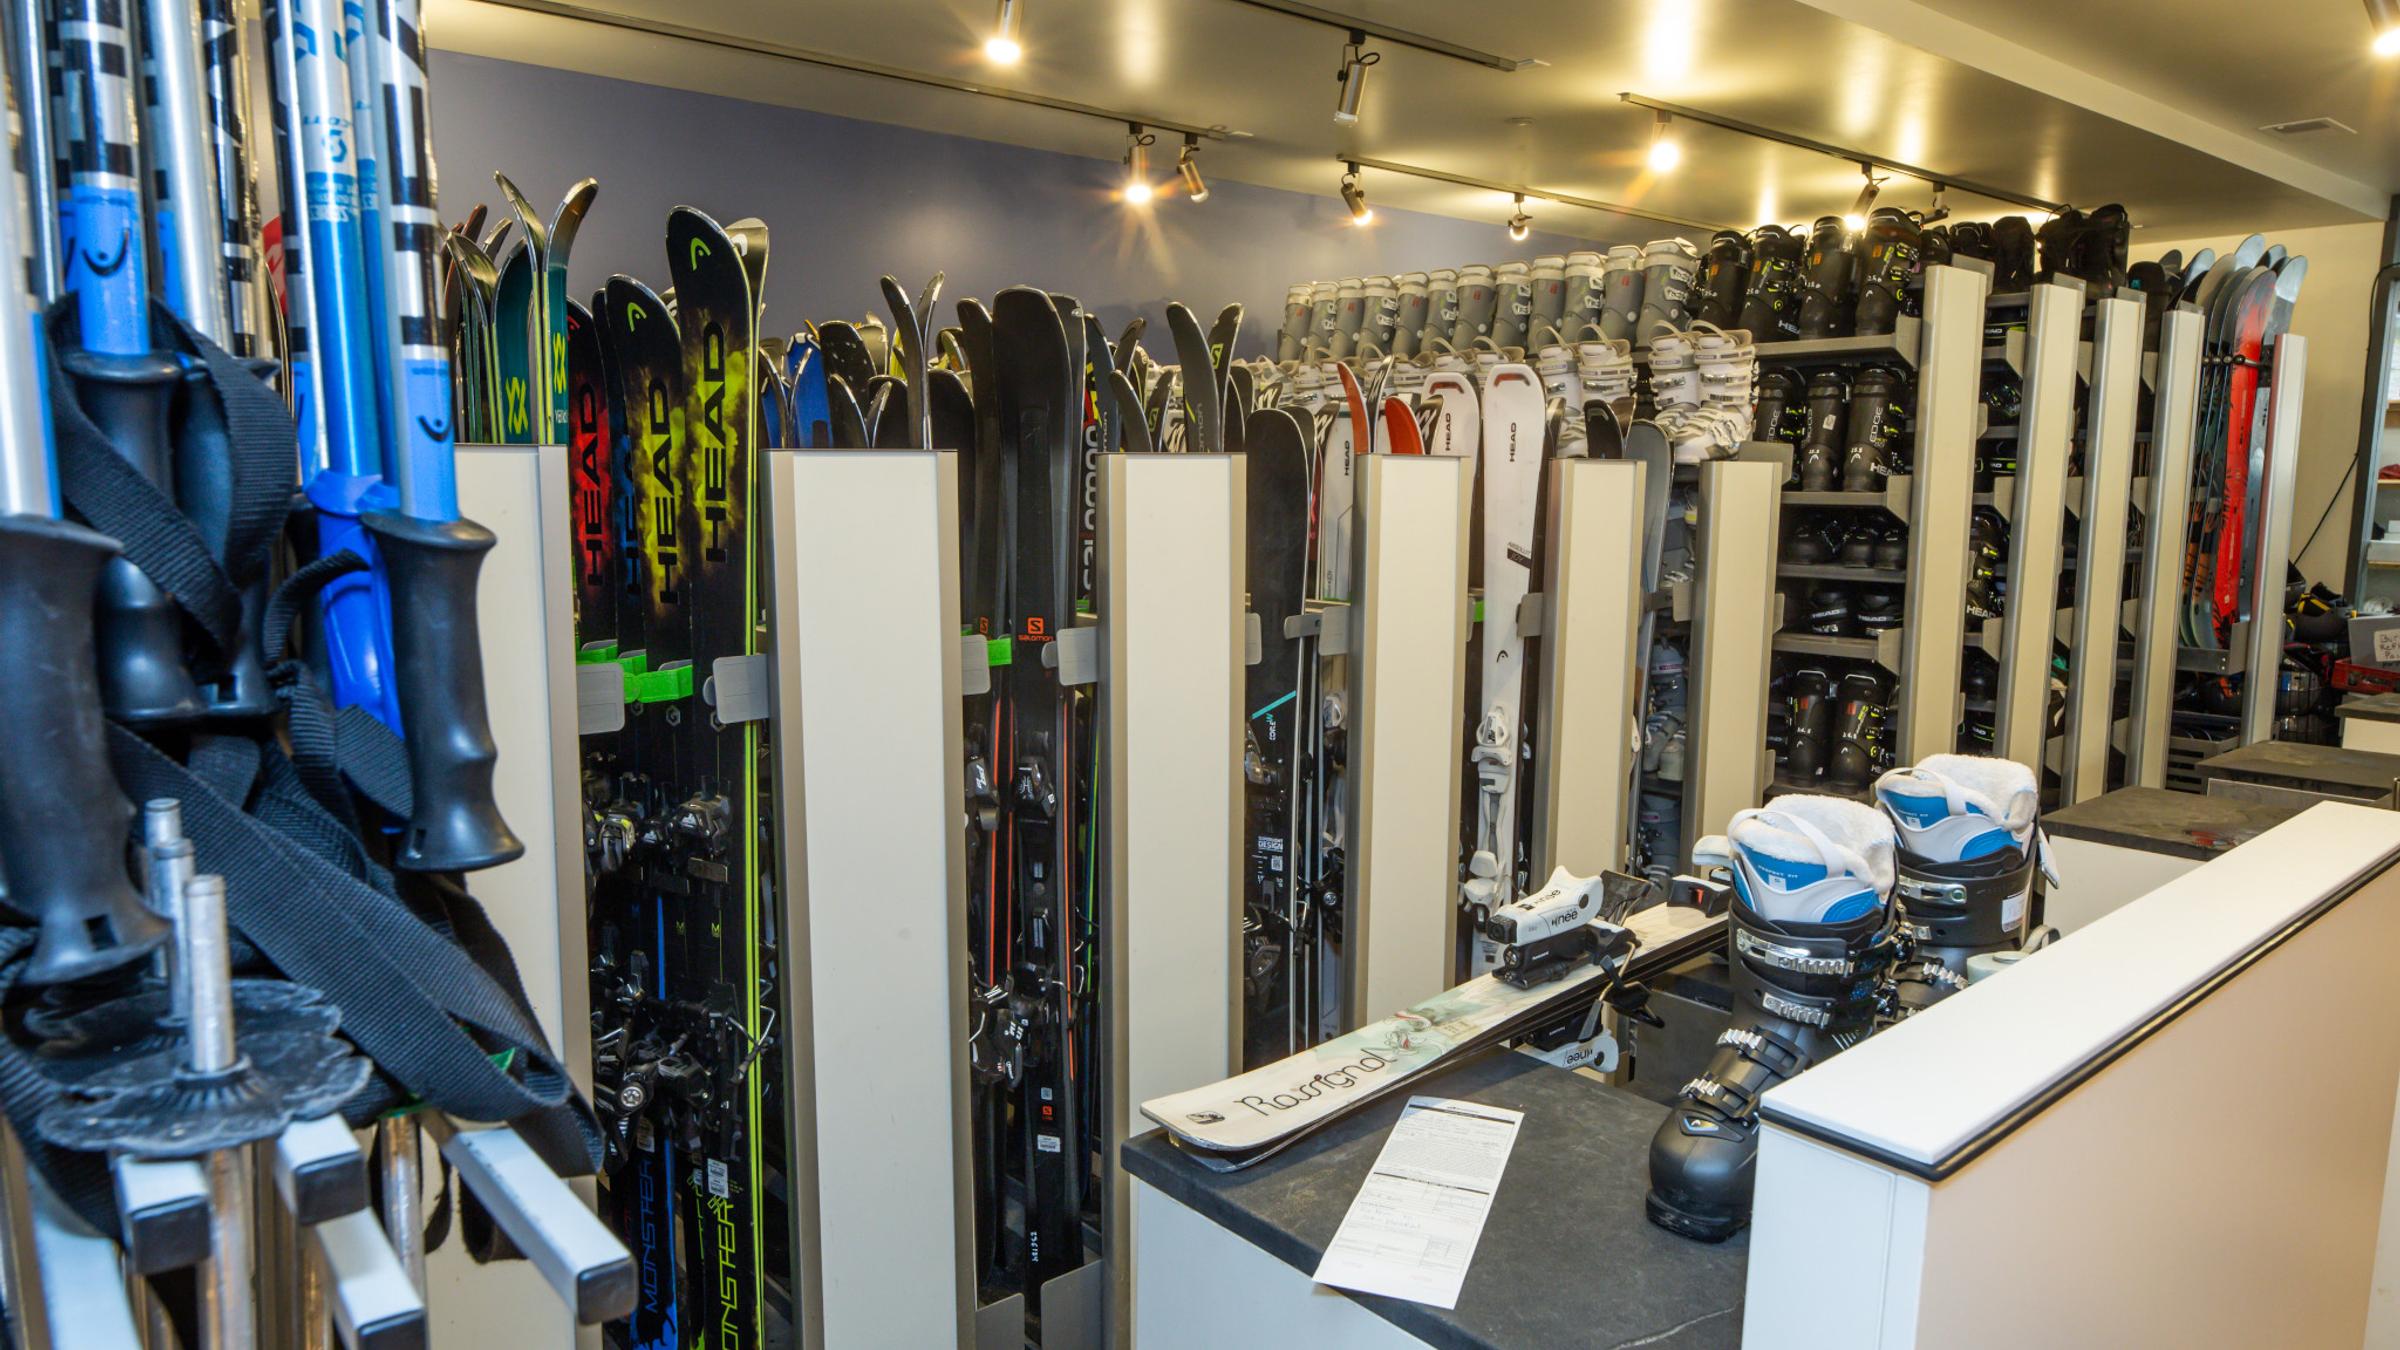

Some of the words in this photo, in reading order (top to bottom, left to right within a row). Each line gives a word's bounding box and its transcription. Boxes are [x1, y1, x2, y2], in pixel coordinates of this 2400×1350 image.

[1778, 319, 1800, 334] HEA
[579, 383, 603, 585] HEAD
[650, 378, 678, 603] HEAD
[703, 321, 727, 562] HEAD
[1233, 1048, 1397, 1116] Rossignol
[638, 1159, 658, 1313] MONSTER
[717, 1198, 739, 1350] ONSTER
